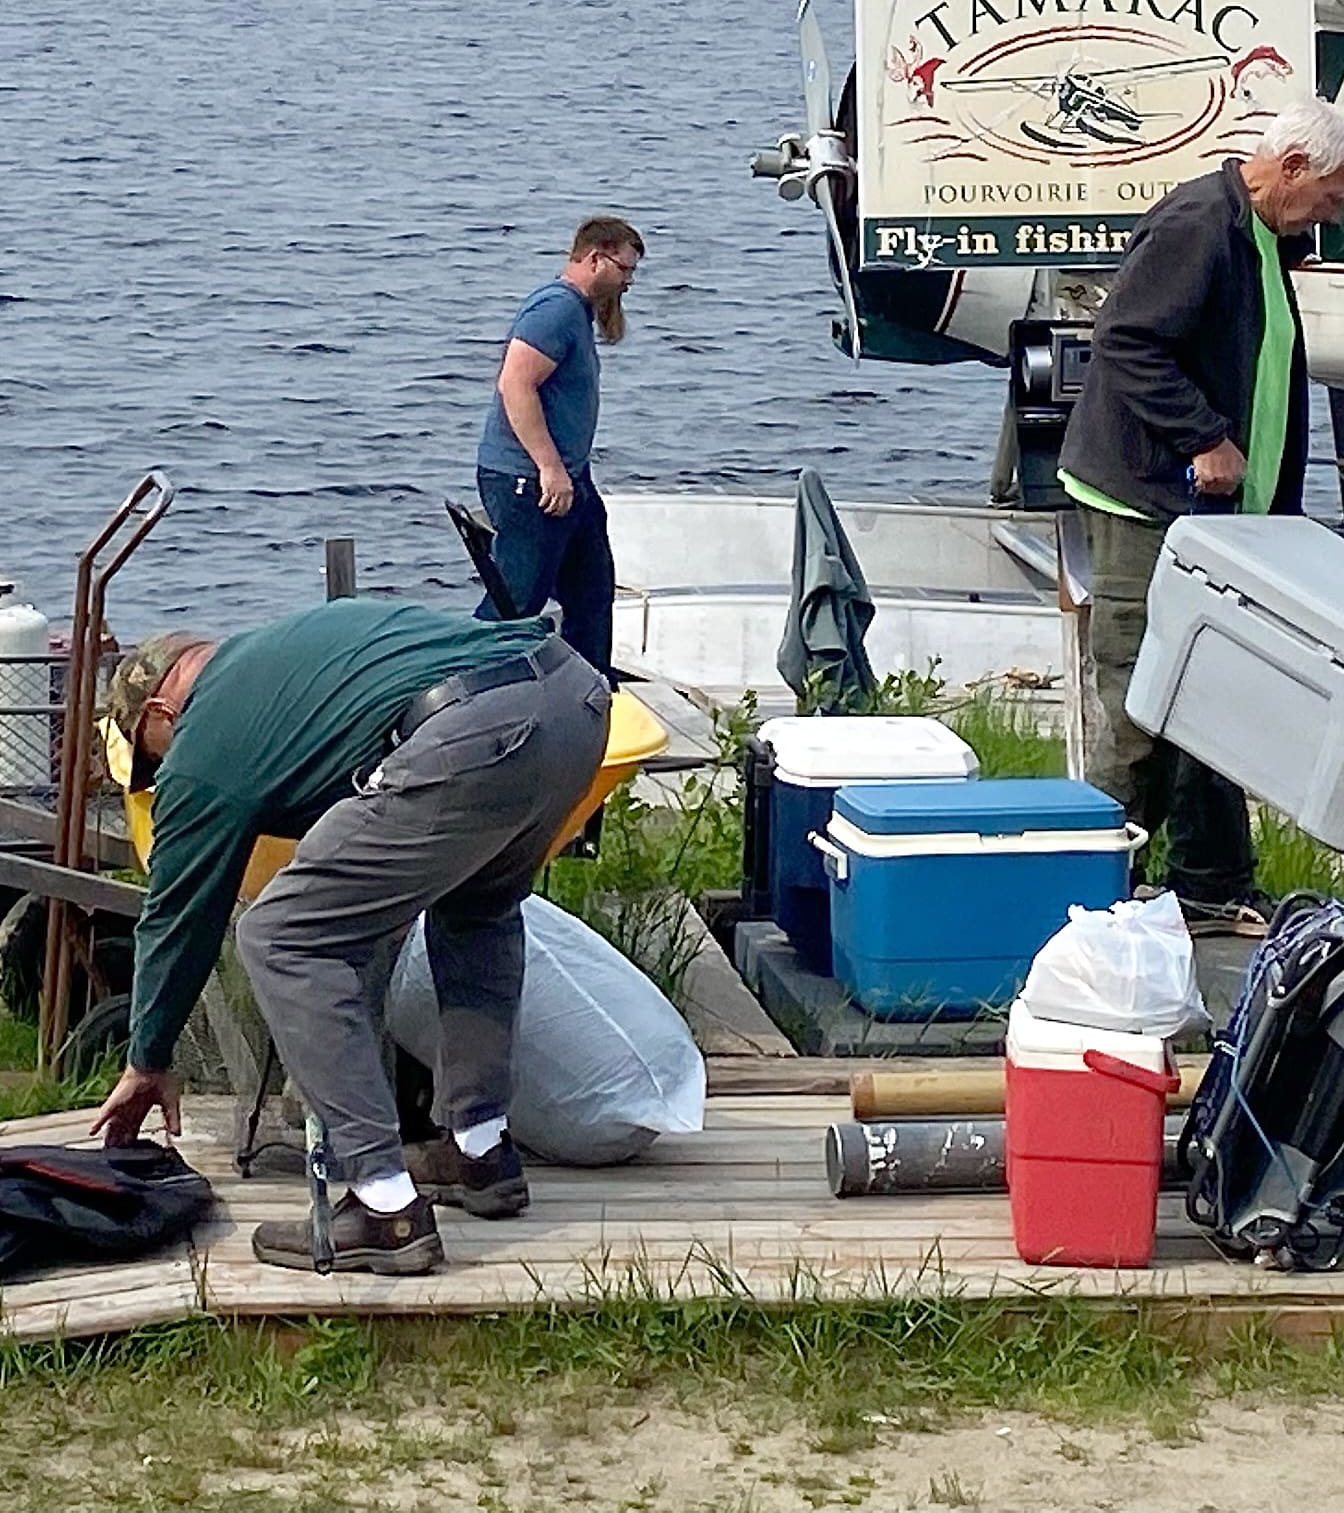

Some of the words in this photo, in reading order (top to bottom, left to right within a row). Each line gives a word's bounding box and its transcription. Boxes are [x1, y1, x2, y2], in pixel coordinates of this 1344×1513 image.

[924, 182, 1088, 204] POURVOIRIE
[1117, 181, 1174, 201] OUT
[875, 225, 999, 266] Fly-in
[1015, 224, 1134, 255] fishin
